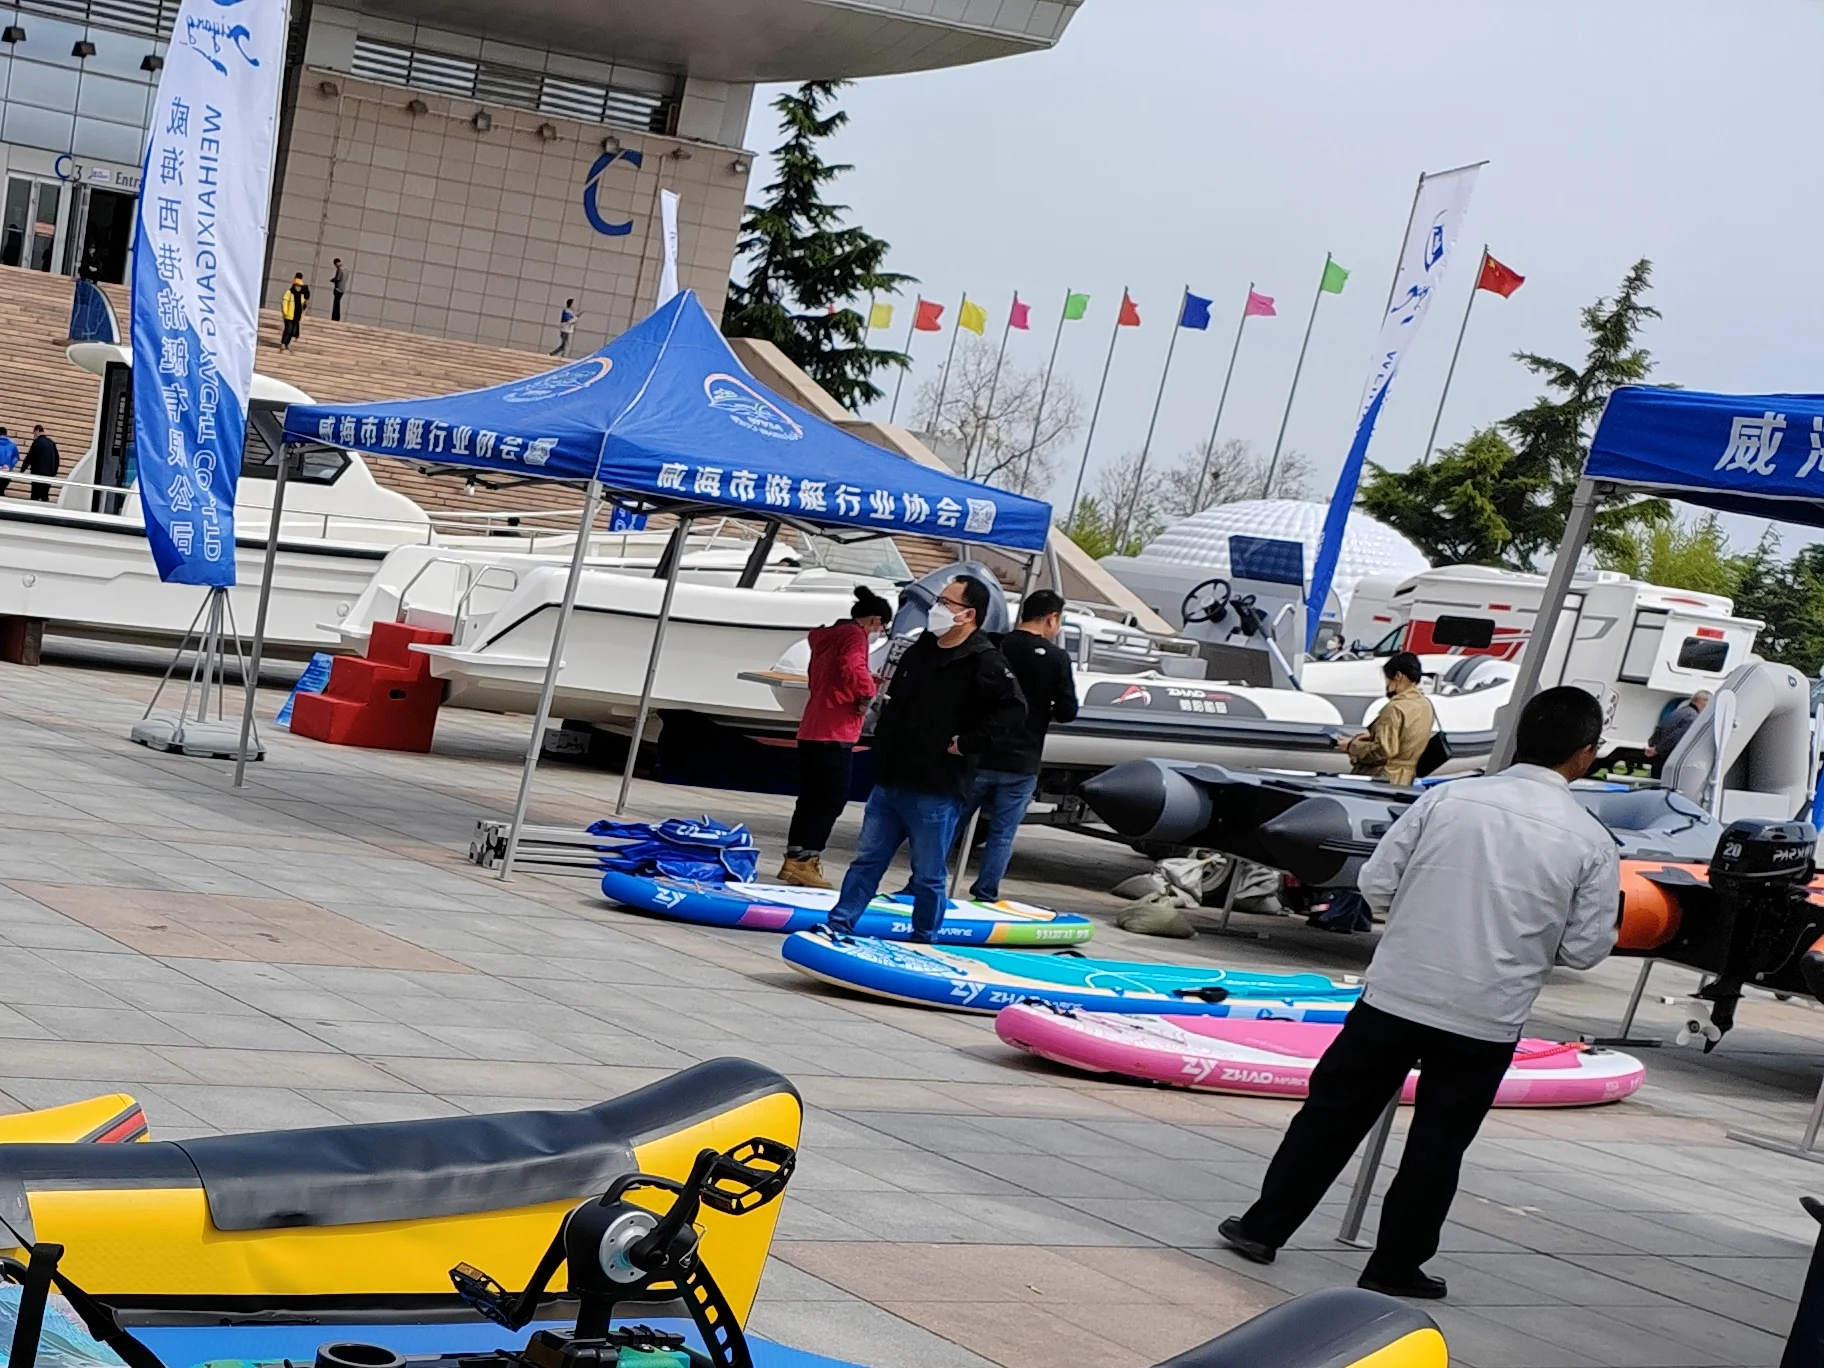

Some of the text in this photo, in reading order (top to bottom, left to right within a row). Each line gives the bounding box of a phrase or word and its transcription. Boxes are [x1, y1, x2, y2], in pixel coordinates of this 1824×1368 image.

[115, 171, 141, 191] Entr
[583, 148, 643, 236] C
[657, 462, 964, 529] 威海市游艇行业协会
[1220, 1067, 1273, 1085] ZHAO
